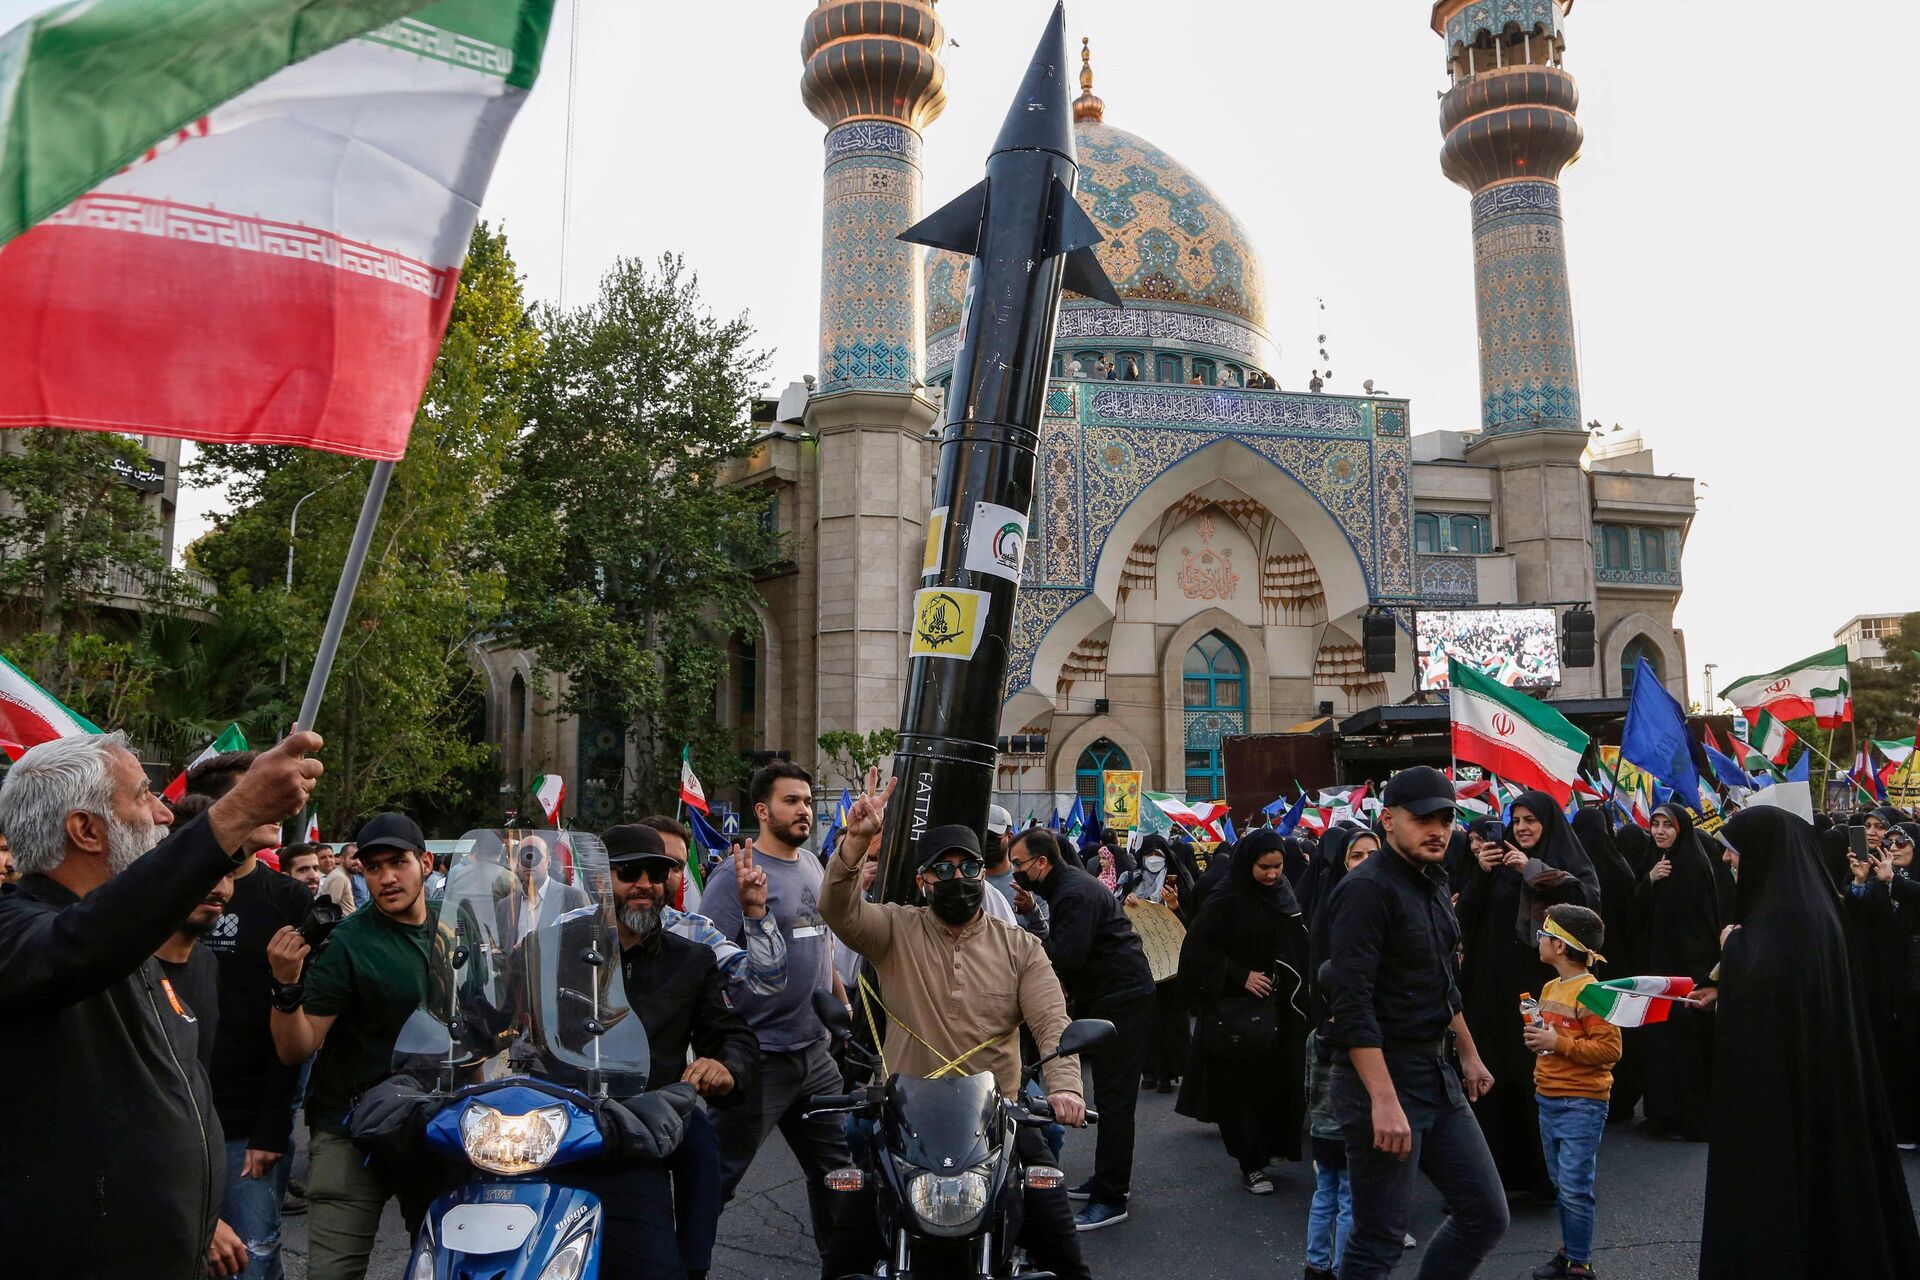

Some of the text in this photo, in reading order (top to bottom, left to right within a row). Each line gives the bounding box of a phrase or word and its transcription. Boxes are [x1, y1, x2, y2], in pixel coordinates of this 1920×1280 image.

[109, 458, 133, 476] عینک
[485, 1189, 513, 1201] TVS
[555, 1205, 588, 1230] wego
